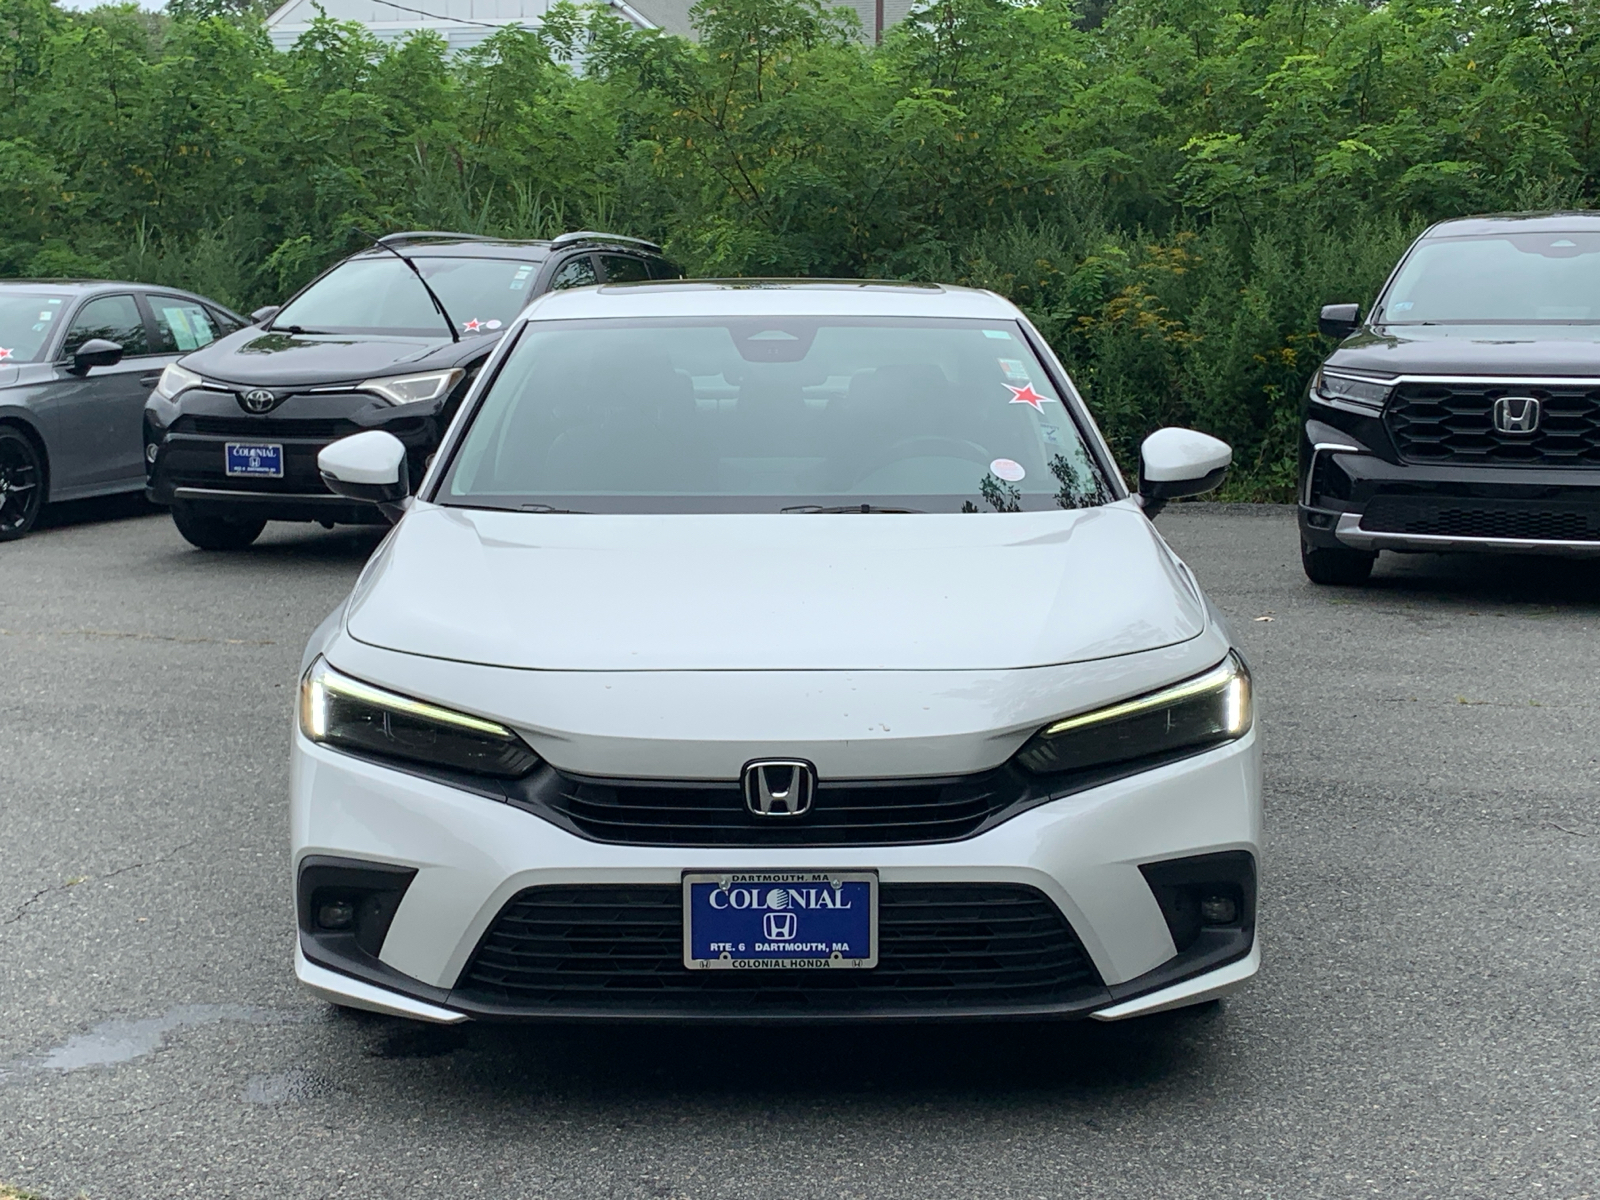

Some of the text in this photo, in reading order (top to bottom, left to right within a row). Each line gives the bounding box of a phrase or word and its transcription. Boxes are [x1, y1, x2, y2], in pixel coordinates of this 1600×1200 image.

[233, 448, 276, 457] COLONIAL
[709, 888, 851, 910] COLONIAL
[710, 943, 850, 953] RTE. 6 DARTMOUTH, MA
[732, 960, 830, 968] COLONIAL HONDA
